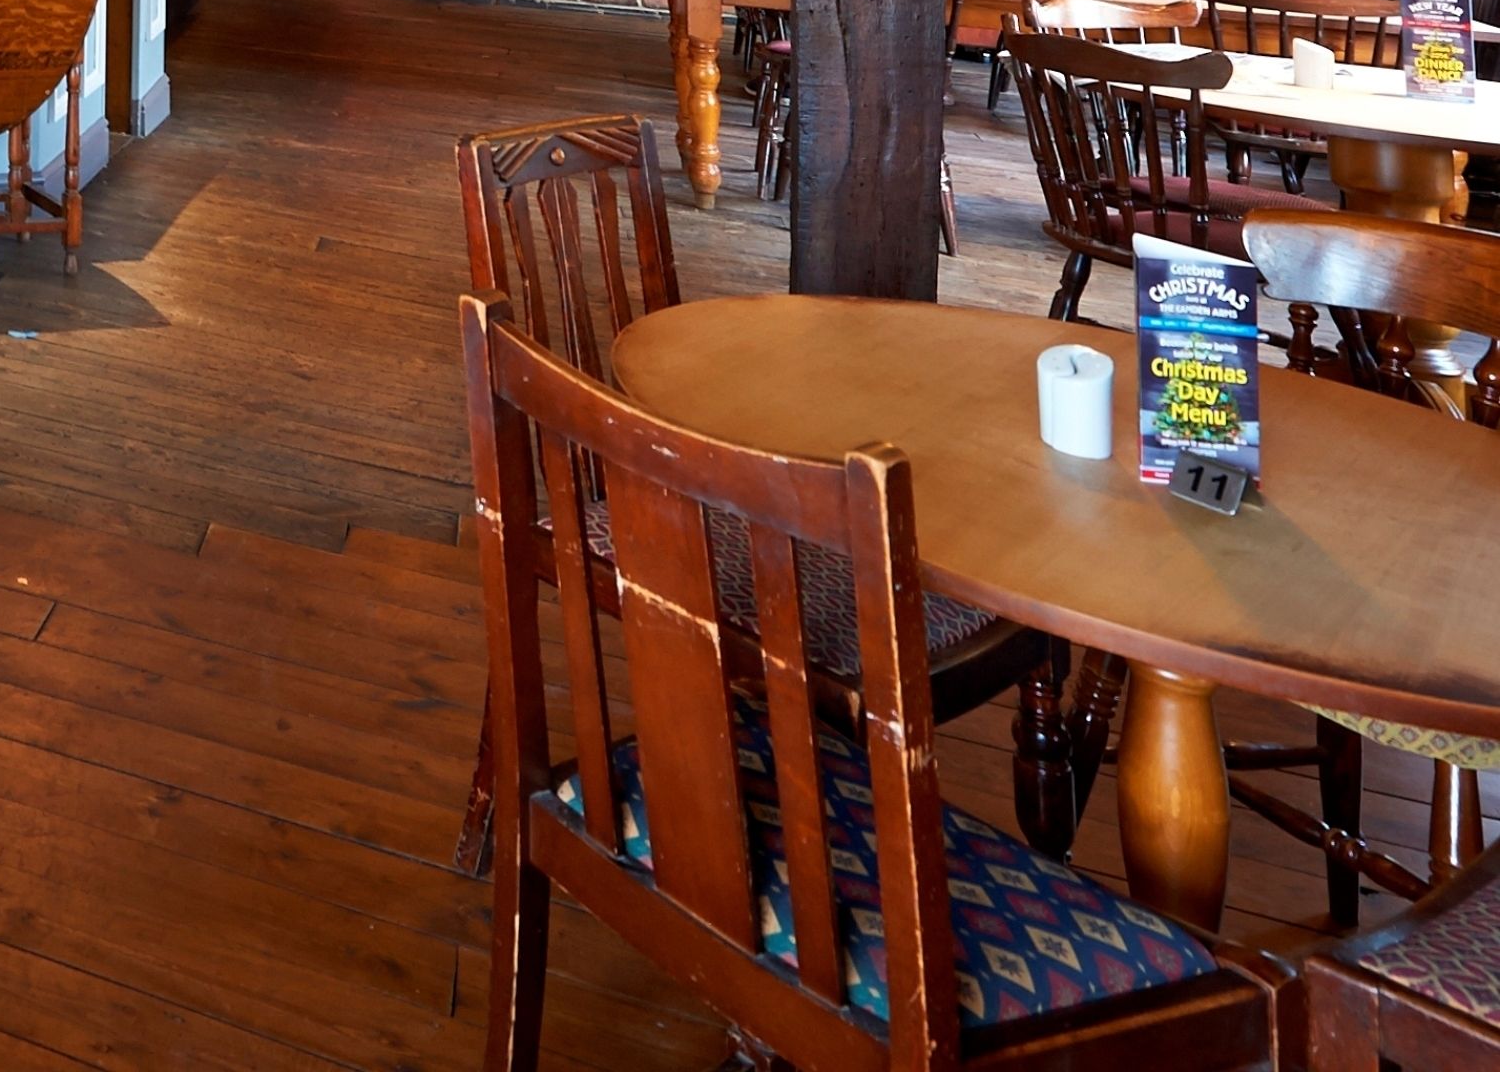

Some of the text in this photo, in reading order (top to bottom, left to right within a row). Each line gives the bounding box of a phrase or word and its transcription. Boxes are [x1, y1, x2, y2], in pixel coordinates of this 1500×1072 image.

[1408, 1, 1464, 17] NEW YEAR
[1414, 57, 1464, 72] DINNER
[1169, 263, 1225, 280] Celebrate
[1148, 276, 1250, 311] CHRISTMAS
[1159, 303, 1175, 314] THE
[1211, 308, 1239, 320] ARMS
[1150, 357, 1249, 385] Christmas
[1177, 381, 1220, 406] Day
[1170, 402, 1228, 426] Menu
[1187, 465, 1229, 501] 11
